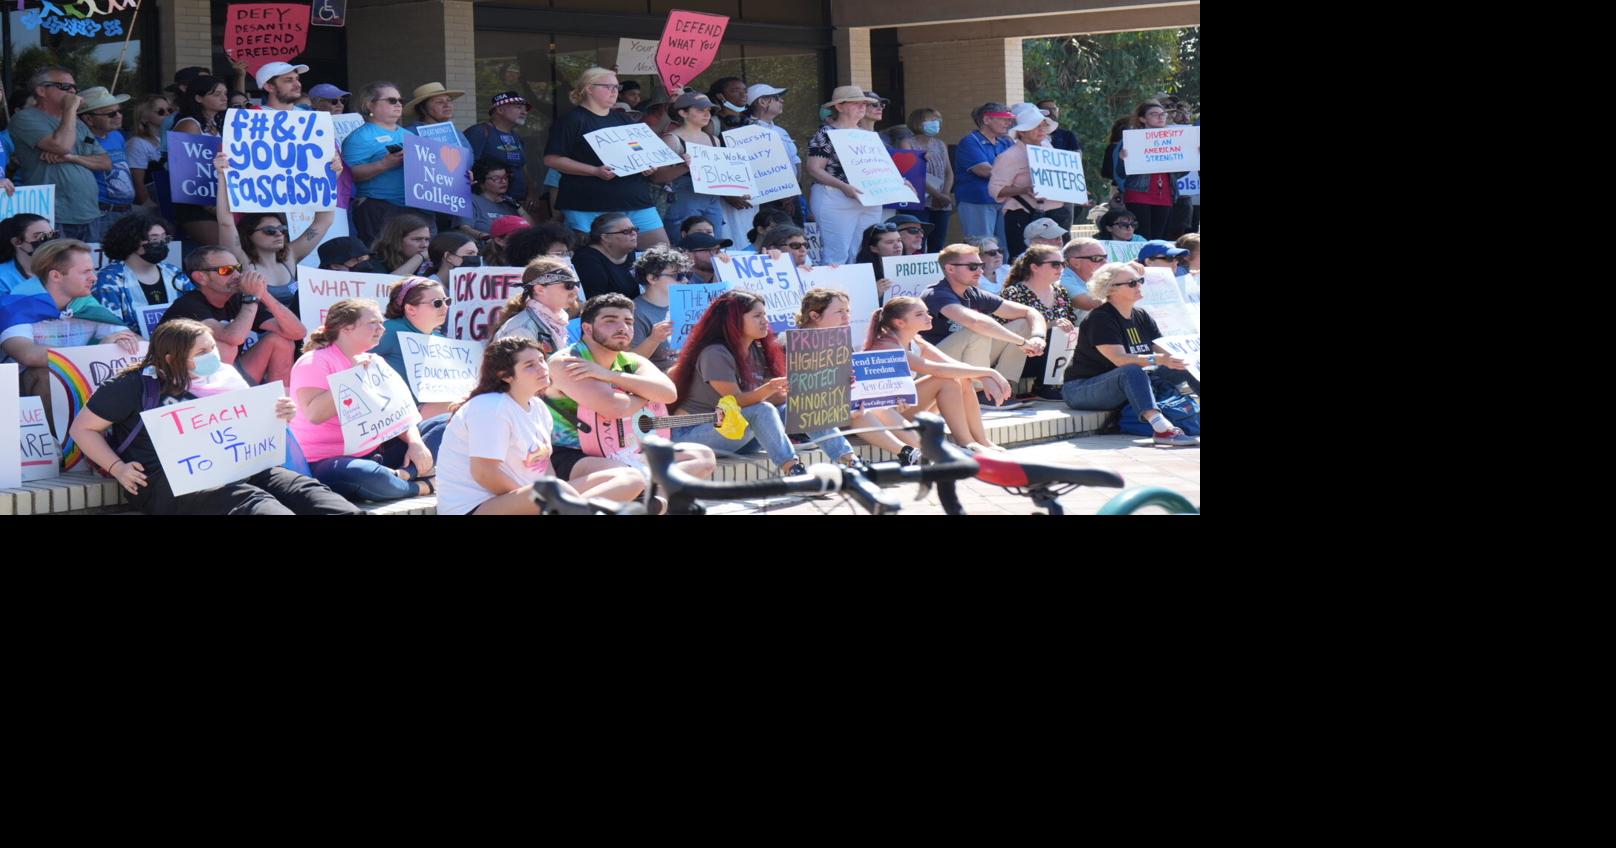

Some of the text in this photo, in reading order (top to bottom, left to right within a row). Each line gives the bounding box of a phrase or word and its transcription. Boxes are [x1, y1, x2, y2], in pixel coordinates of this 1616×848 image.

[237, 8, 290, 22] DEFY
[235, 23, 303, 34] DESANTIS
[675, 19, 722, 37] DEFEND
[236, 33, 294, 46] DEFEND
[668, 36, 695, 51] WHAT
[236, 45, 300, 59] FREEDOM
[665, 54, 698, 68] LOVE
[595, 126, 653, 148] ALL ARE
[1145, 129, 1184, 139] DIVERSITY
[182, 142, 212, 159] We
[228, 140, 324, 171] your
[415, 144, 436, 164] We
[1030, 147, 1078, 169] TRUTH
[1144, 146, 1181, 154] AMERICAN
[1145, 153, 1184, 162] STRENGTH
[610, 147, 678, 173] WELCOME
[227, 161, 338, 208] fascism!
[424, 166, 454, 187] New
[1031, 168, 1086, 192] MATTERS
[413, 184, 466, 212] College
[732, 255, 774, 279] NCF
[896, 260, 939, 277] PROTECT
[309, 278, 366, 297] WHAT
[676, 289, 704, 310] THE
[791, 328, 849, 351] PROTECT
[789, 345, 850, 372] HIGHER ED
[790, 367, 838, 391] PROTECT
[864, 366, 896, 375] Freedom
[20, 408, 43, 423] UE
[799, 403, 849, 429] STUDENTS
[210, 427, 238, 445] US
